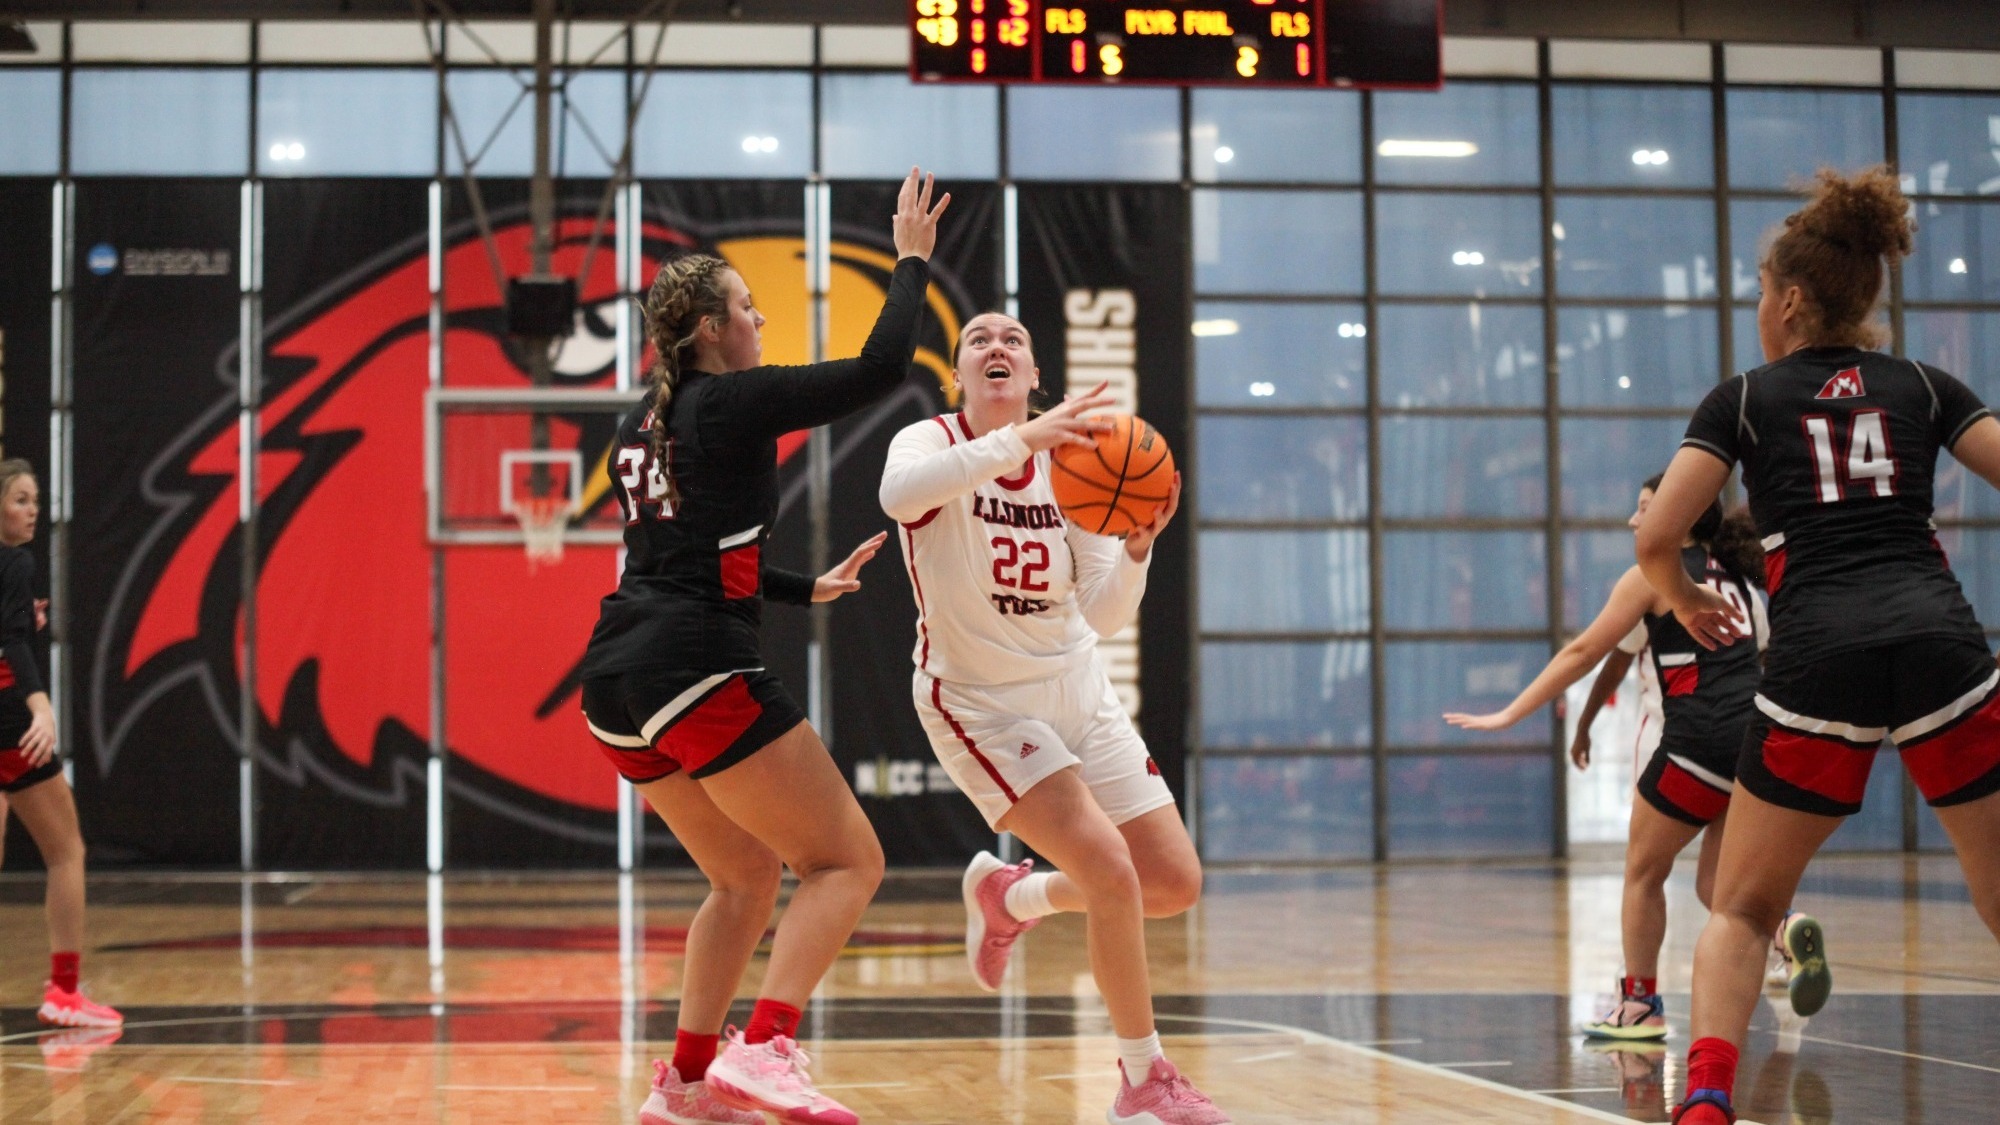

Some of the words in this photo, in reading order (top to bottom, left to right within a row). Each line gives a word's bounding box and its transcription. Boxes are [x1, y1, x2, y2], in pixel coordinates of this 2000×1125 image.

[1045, 8, 1087, 34] FLS
[1183, 10, 1235, 36] FOUL
[1270, 11, 1311, 37] FLS
[1071, 39, 1086, 73] 1
[1297, 43, 1310, 76] 1
[1802, 408, 1900, 503] 14
[616, 442, 676, 526] 24
[991, 536, 1050, 592] 22
